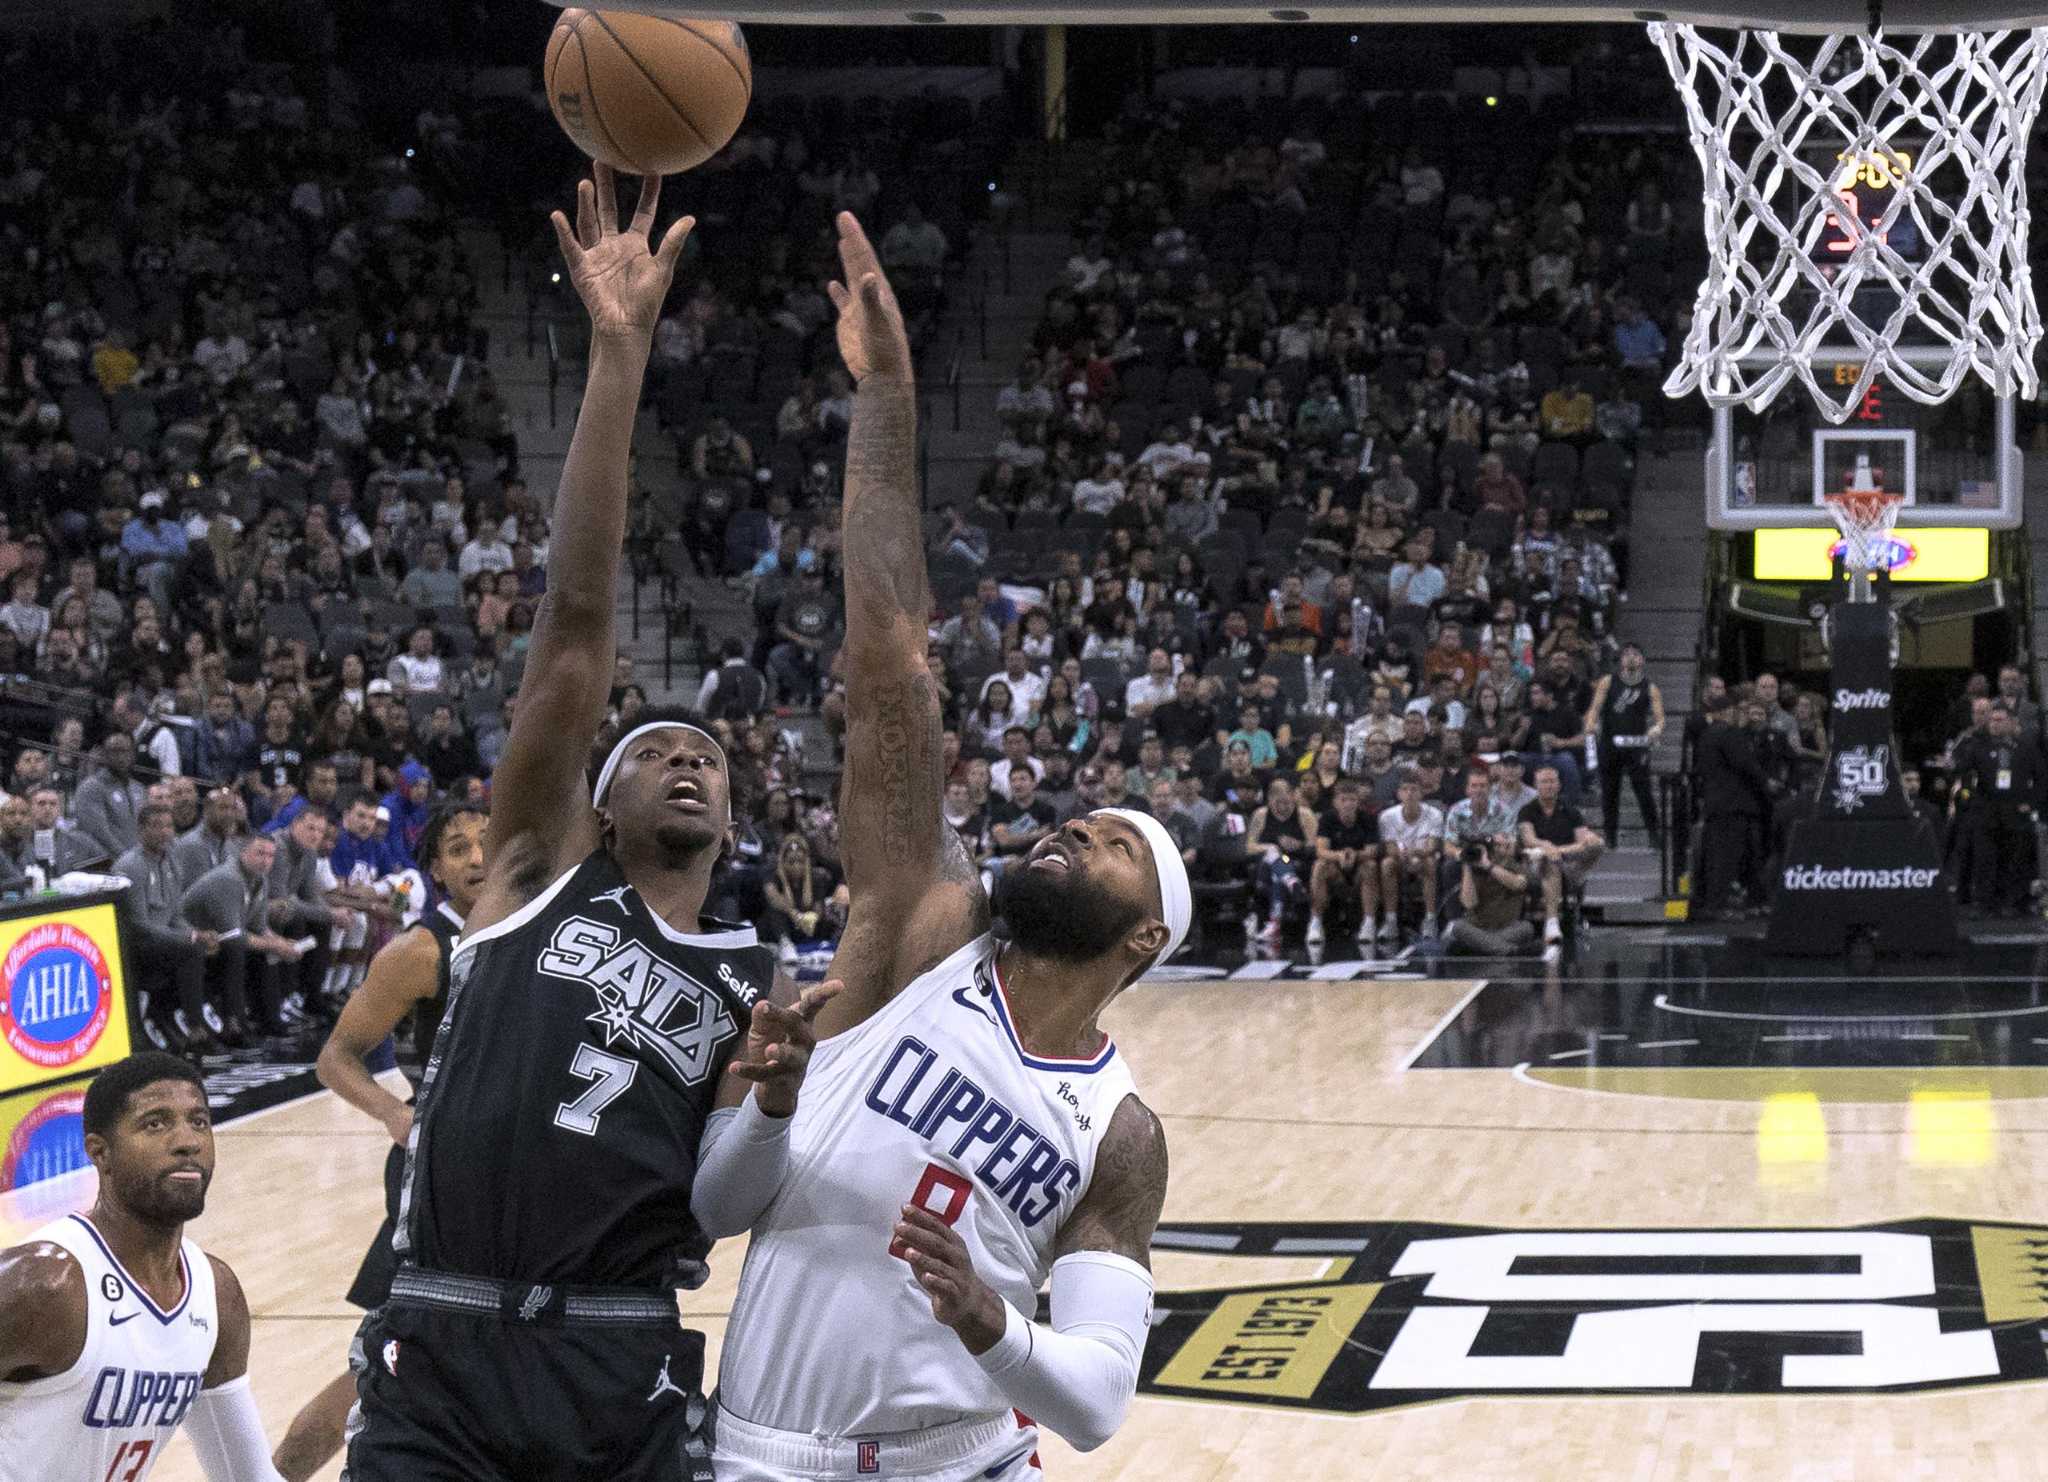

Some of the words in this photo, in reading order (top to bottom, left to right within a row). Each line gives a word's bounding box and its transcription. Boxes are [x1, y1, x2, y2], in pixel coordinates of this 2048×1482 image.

[1833, 687, 1891, 712] Sprite
[1840, 761, 1885, 786] 50
[1784, 864, 1940, 890] ticketmaster
[20, 957, 91, 1027] AHIA
[537, 914, 739, 1087] SATX
[553, 1042, 639, 1136] 7
[865, 1034, 1081, 1229] CLIPPERS
[1235, 1297, 1333, 1338] 1973
[1201, 1345, 1297, 1381] EST
[82, 1365, 206, 1430] CLIPPER
